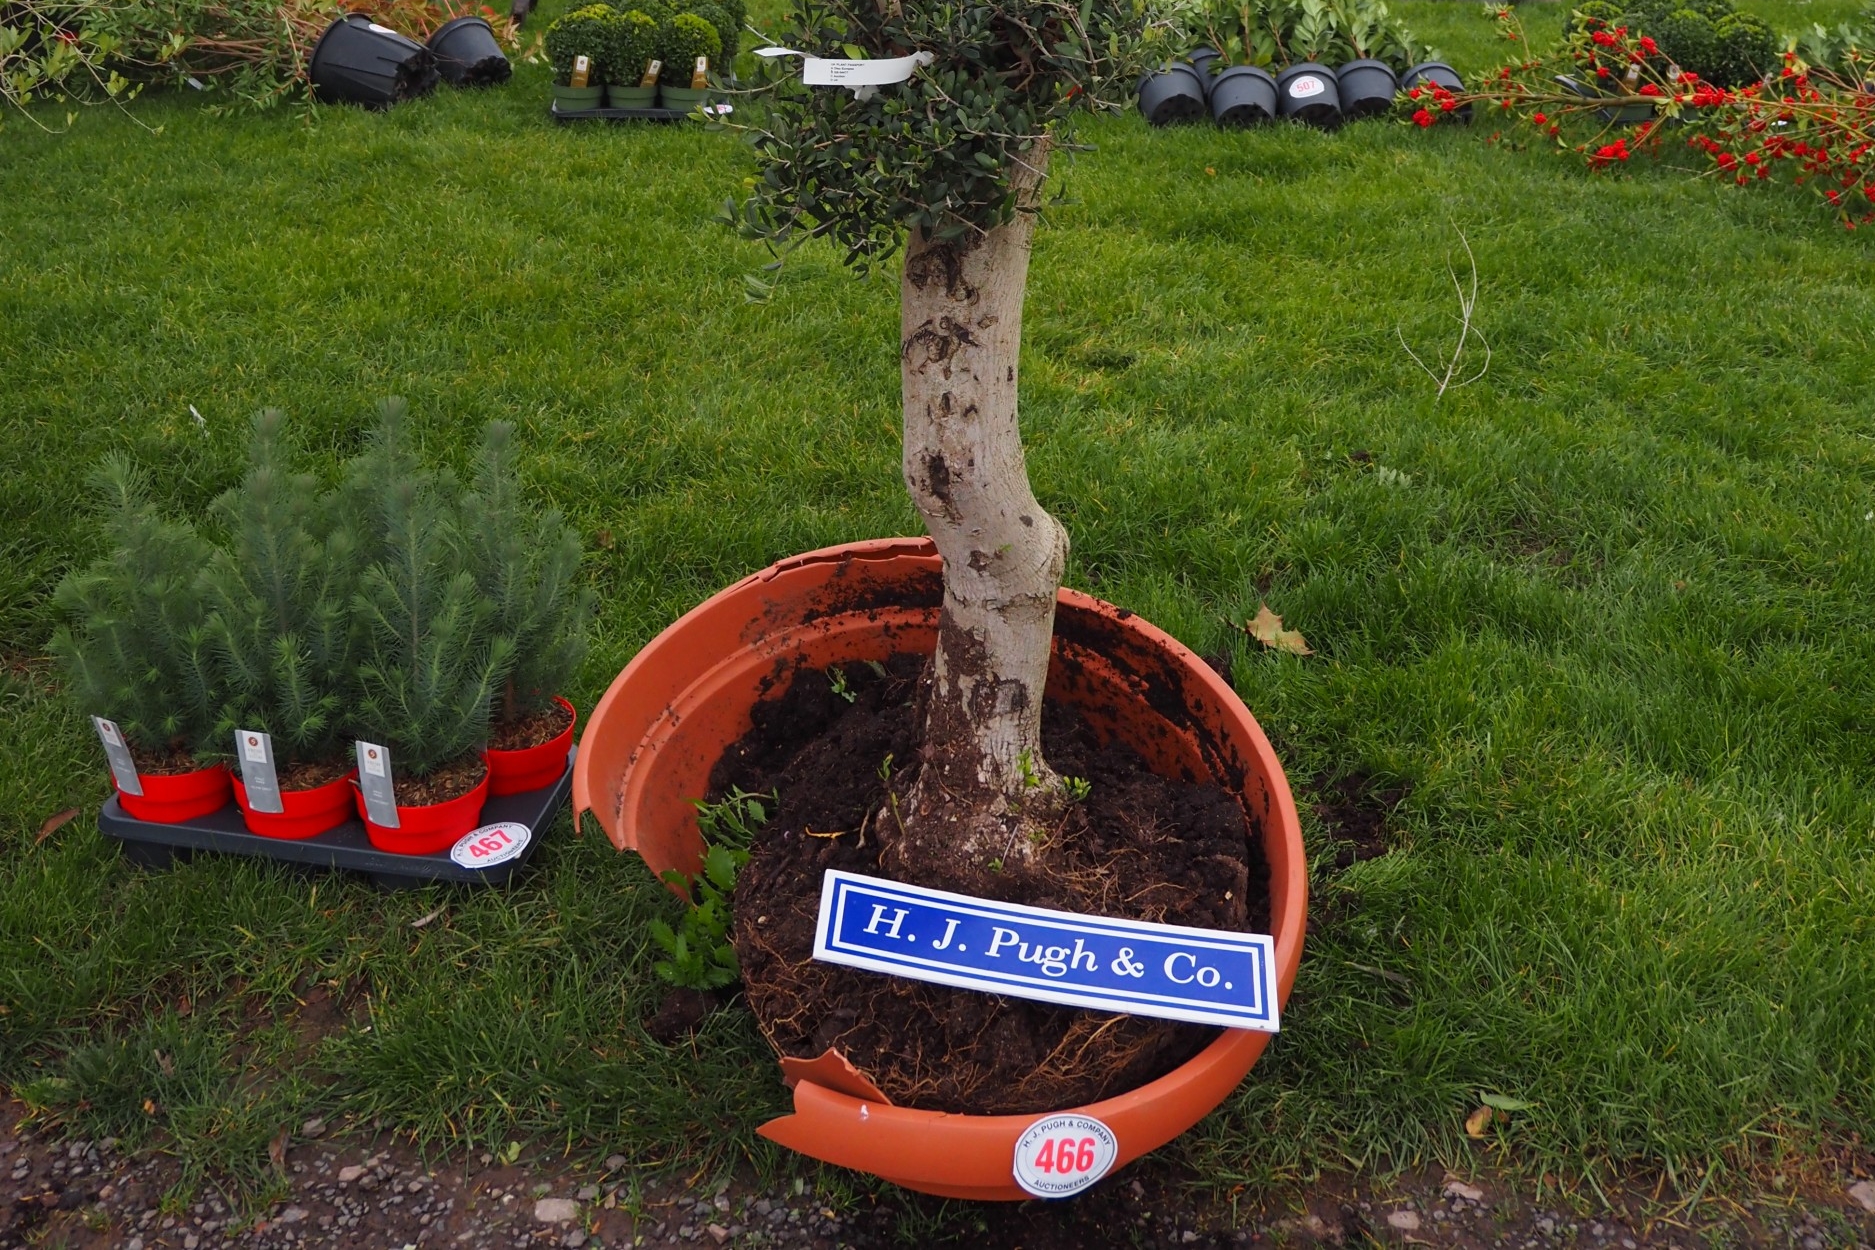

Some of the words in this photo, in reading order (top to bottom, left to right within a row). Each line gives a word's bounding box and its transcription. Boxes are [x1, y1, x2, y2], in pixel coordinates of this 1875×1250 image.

[1296, 80, 1315, 92] 507
[469, 829, 512, 858] 467
[863, 903, 917, 943] H.
[932, 918, 967, 952] J.
[984, 926, 1098, 978] Pugh
[1111, 947, 1145, 978] &
[1163, 952, 1234, 990] Co.
[1023, 1139, 1032, 1148] H.
[1033, 1131, 1040, 1139] J.
[1041, 1120, 1065, 1133] PUGH
[1076, 1120, 1111, 1146] COMPANY
[1034, 1137, 1096, 1174] 466
[1033, 1175, 1090, 1190] AUCTIONEERS
